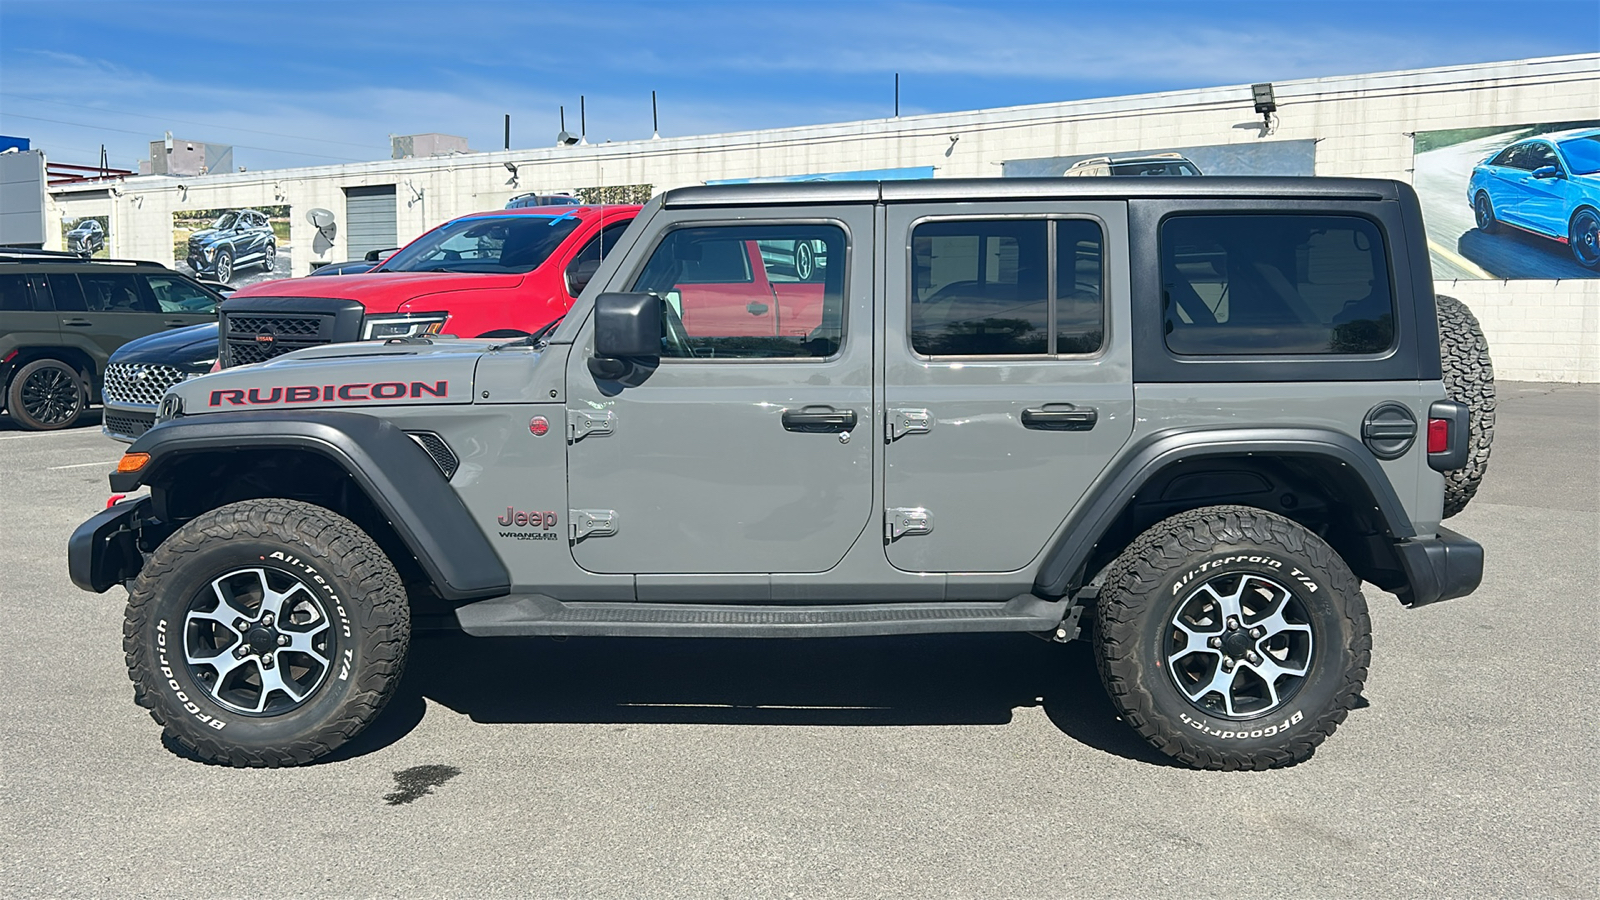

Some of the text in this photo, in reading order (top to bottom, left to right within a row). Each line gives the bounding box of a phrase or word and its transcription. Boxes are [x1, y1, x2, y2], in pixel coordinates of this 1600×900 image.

[209, 380, 449, 407] RUBICON
[498, 506, 558, 530] Jeep
[1172, 555, 1319, 596] All-Terrain T/A
[269, 550, 353, 681] All-Terrain T/A
[156, 619, 227, 731] BFGoodrich
[1179, 710, 1304, 740] BFGoodrich
